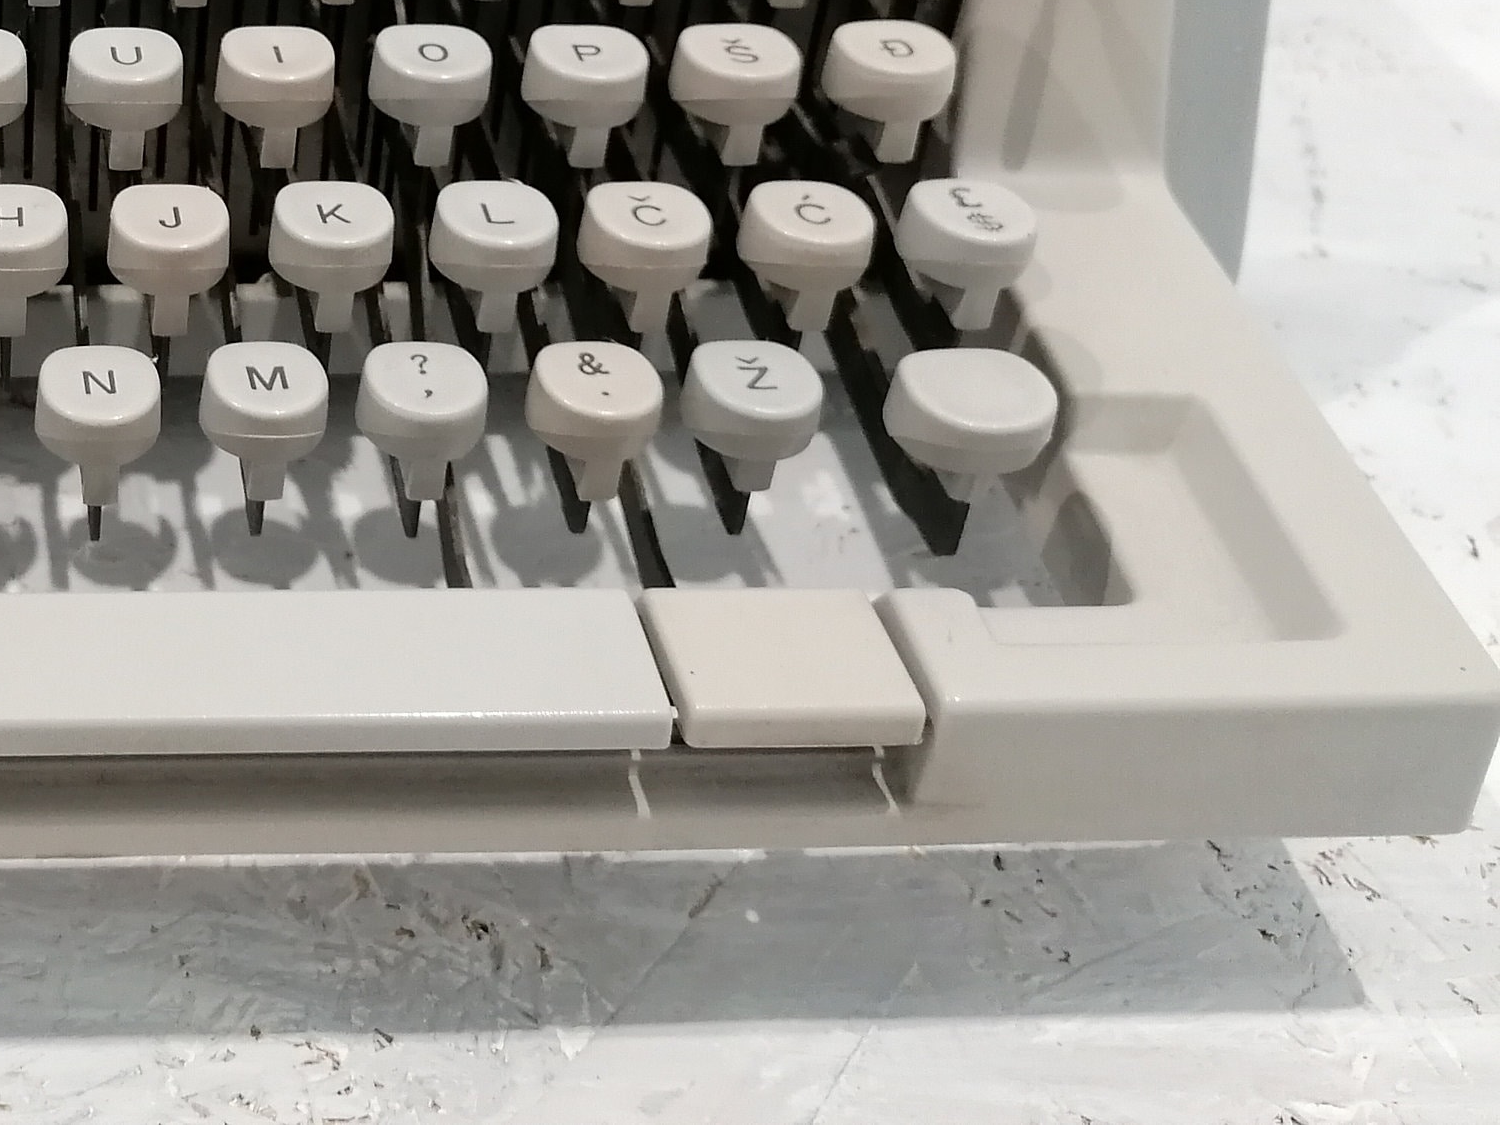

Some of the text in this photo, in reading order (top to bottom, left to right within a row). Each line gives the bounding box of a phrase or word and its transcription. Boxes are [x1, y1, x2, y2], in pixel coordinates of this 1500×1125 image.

[110, 46, 143, 66] U
[272, 45, 284, 64] I
[417, 43, 449, 63] O
[571, 44, 602, 62] P
[723, 38, 760, 64] Š
[158, 206, 182, 229] J
[316, 203, 352, 225] K
[480, 202, 516, 225] L
[629, 195, 667, 227] Č
[793, 194, 832, 226] Ć
[410, 353, 428, 375] ?
[577, 352, 610, 376] &
[735, 356, 778, 391] Ž
[82, 369, 117, 395] N
[245, 365, 290, 392] M
